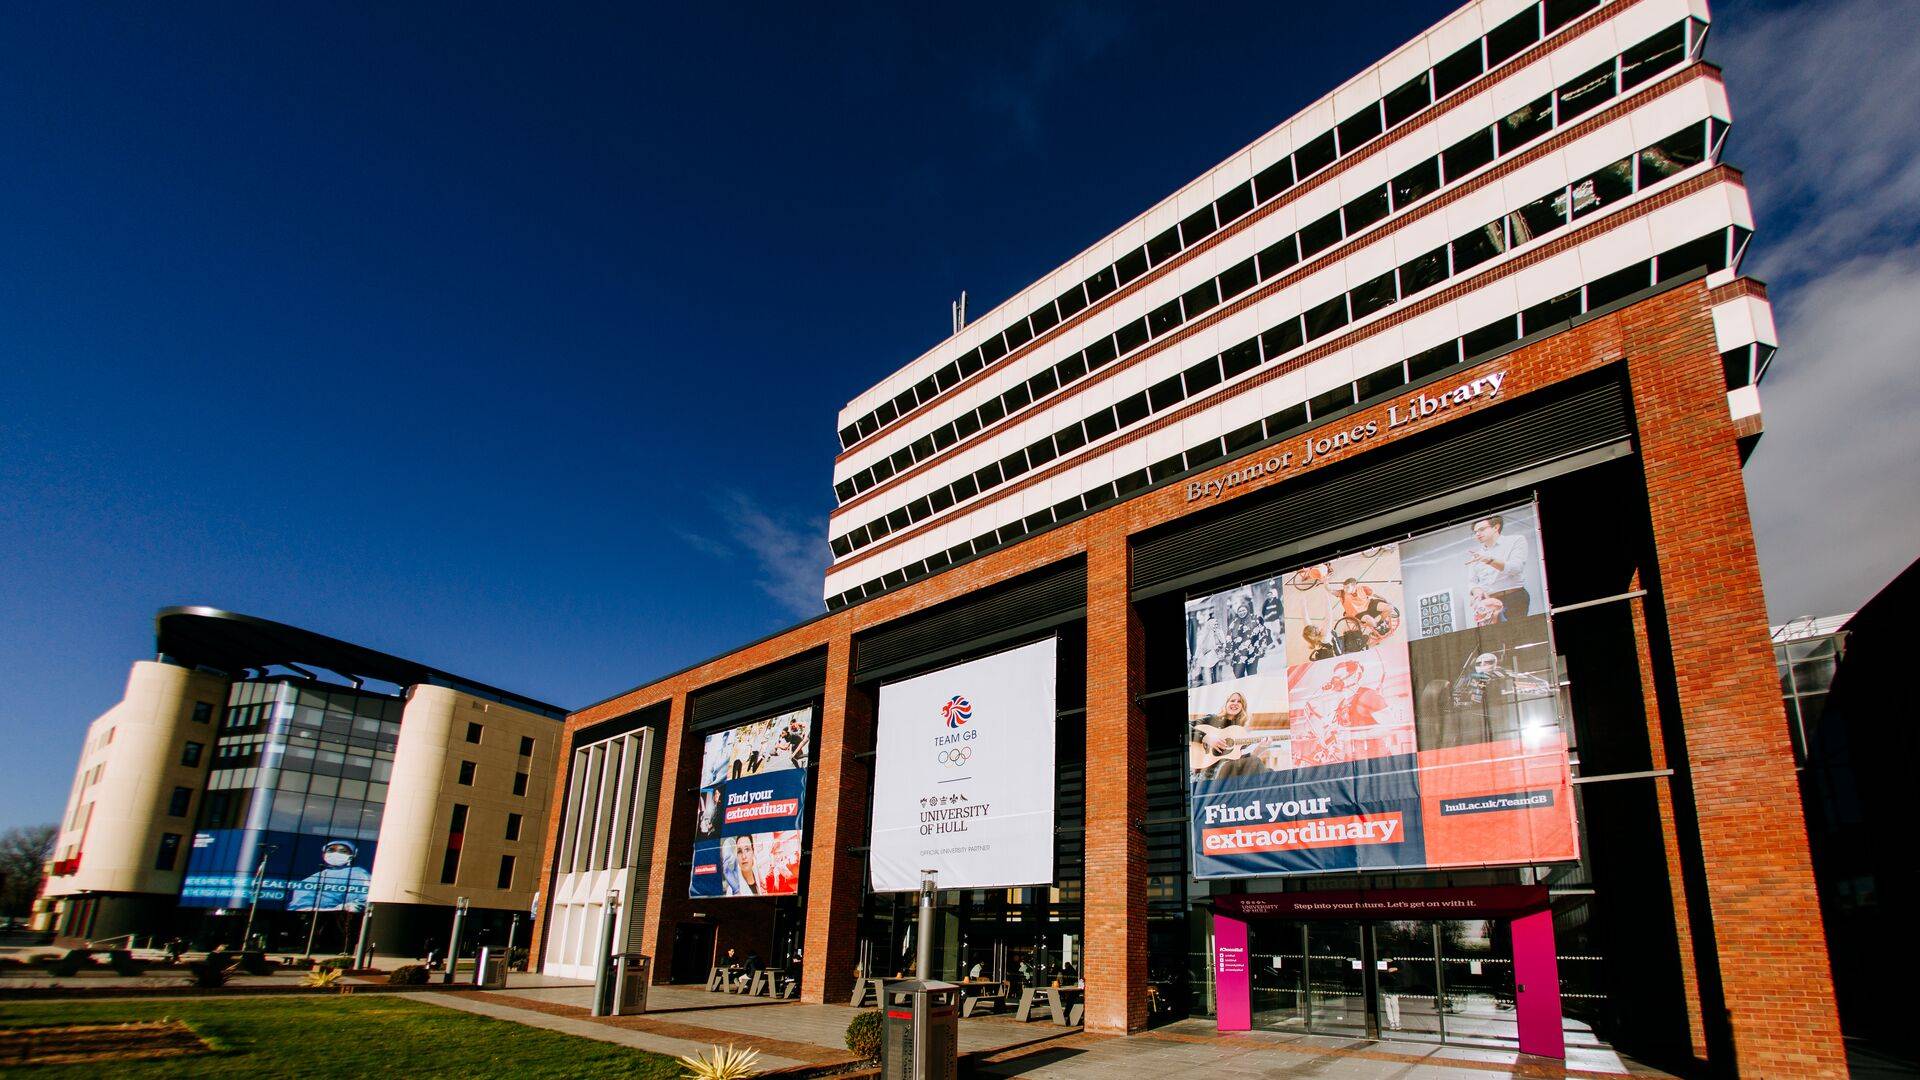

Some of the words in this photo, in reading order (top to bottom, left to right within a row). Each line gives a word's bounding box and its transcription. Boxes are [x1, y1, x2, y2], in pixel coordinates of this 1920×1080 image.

[1186, 451, 1292, 502] Brynmor
[1302, 420, 1377, 466] Jones
[1387, 370, 1507, 429] Library
[935, 733, 960, 746] TEAM
[963, 729, 977, 740] GB
[727, 791, 748, 805] Find
[749, 789, 774, 804] your
[1445, 795, 1548, 812] hull.ac.uk/TeamGB
[726, 802, 796, 820] extraordinary
[920, 804, 990, 822] UNIVERSITY
[1204, 800, 1262, 824] Find
[1266, 797, 1331, 822] your
[920, 824, 934, 836] OF
[936, 821, 968, 834] HULL
[1205, 818, 1399, 850] extraordinary
[324, 884, 369, 894] PEOPLE
[1410, 901, 1425, 909] get
